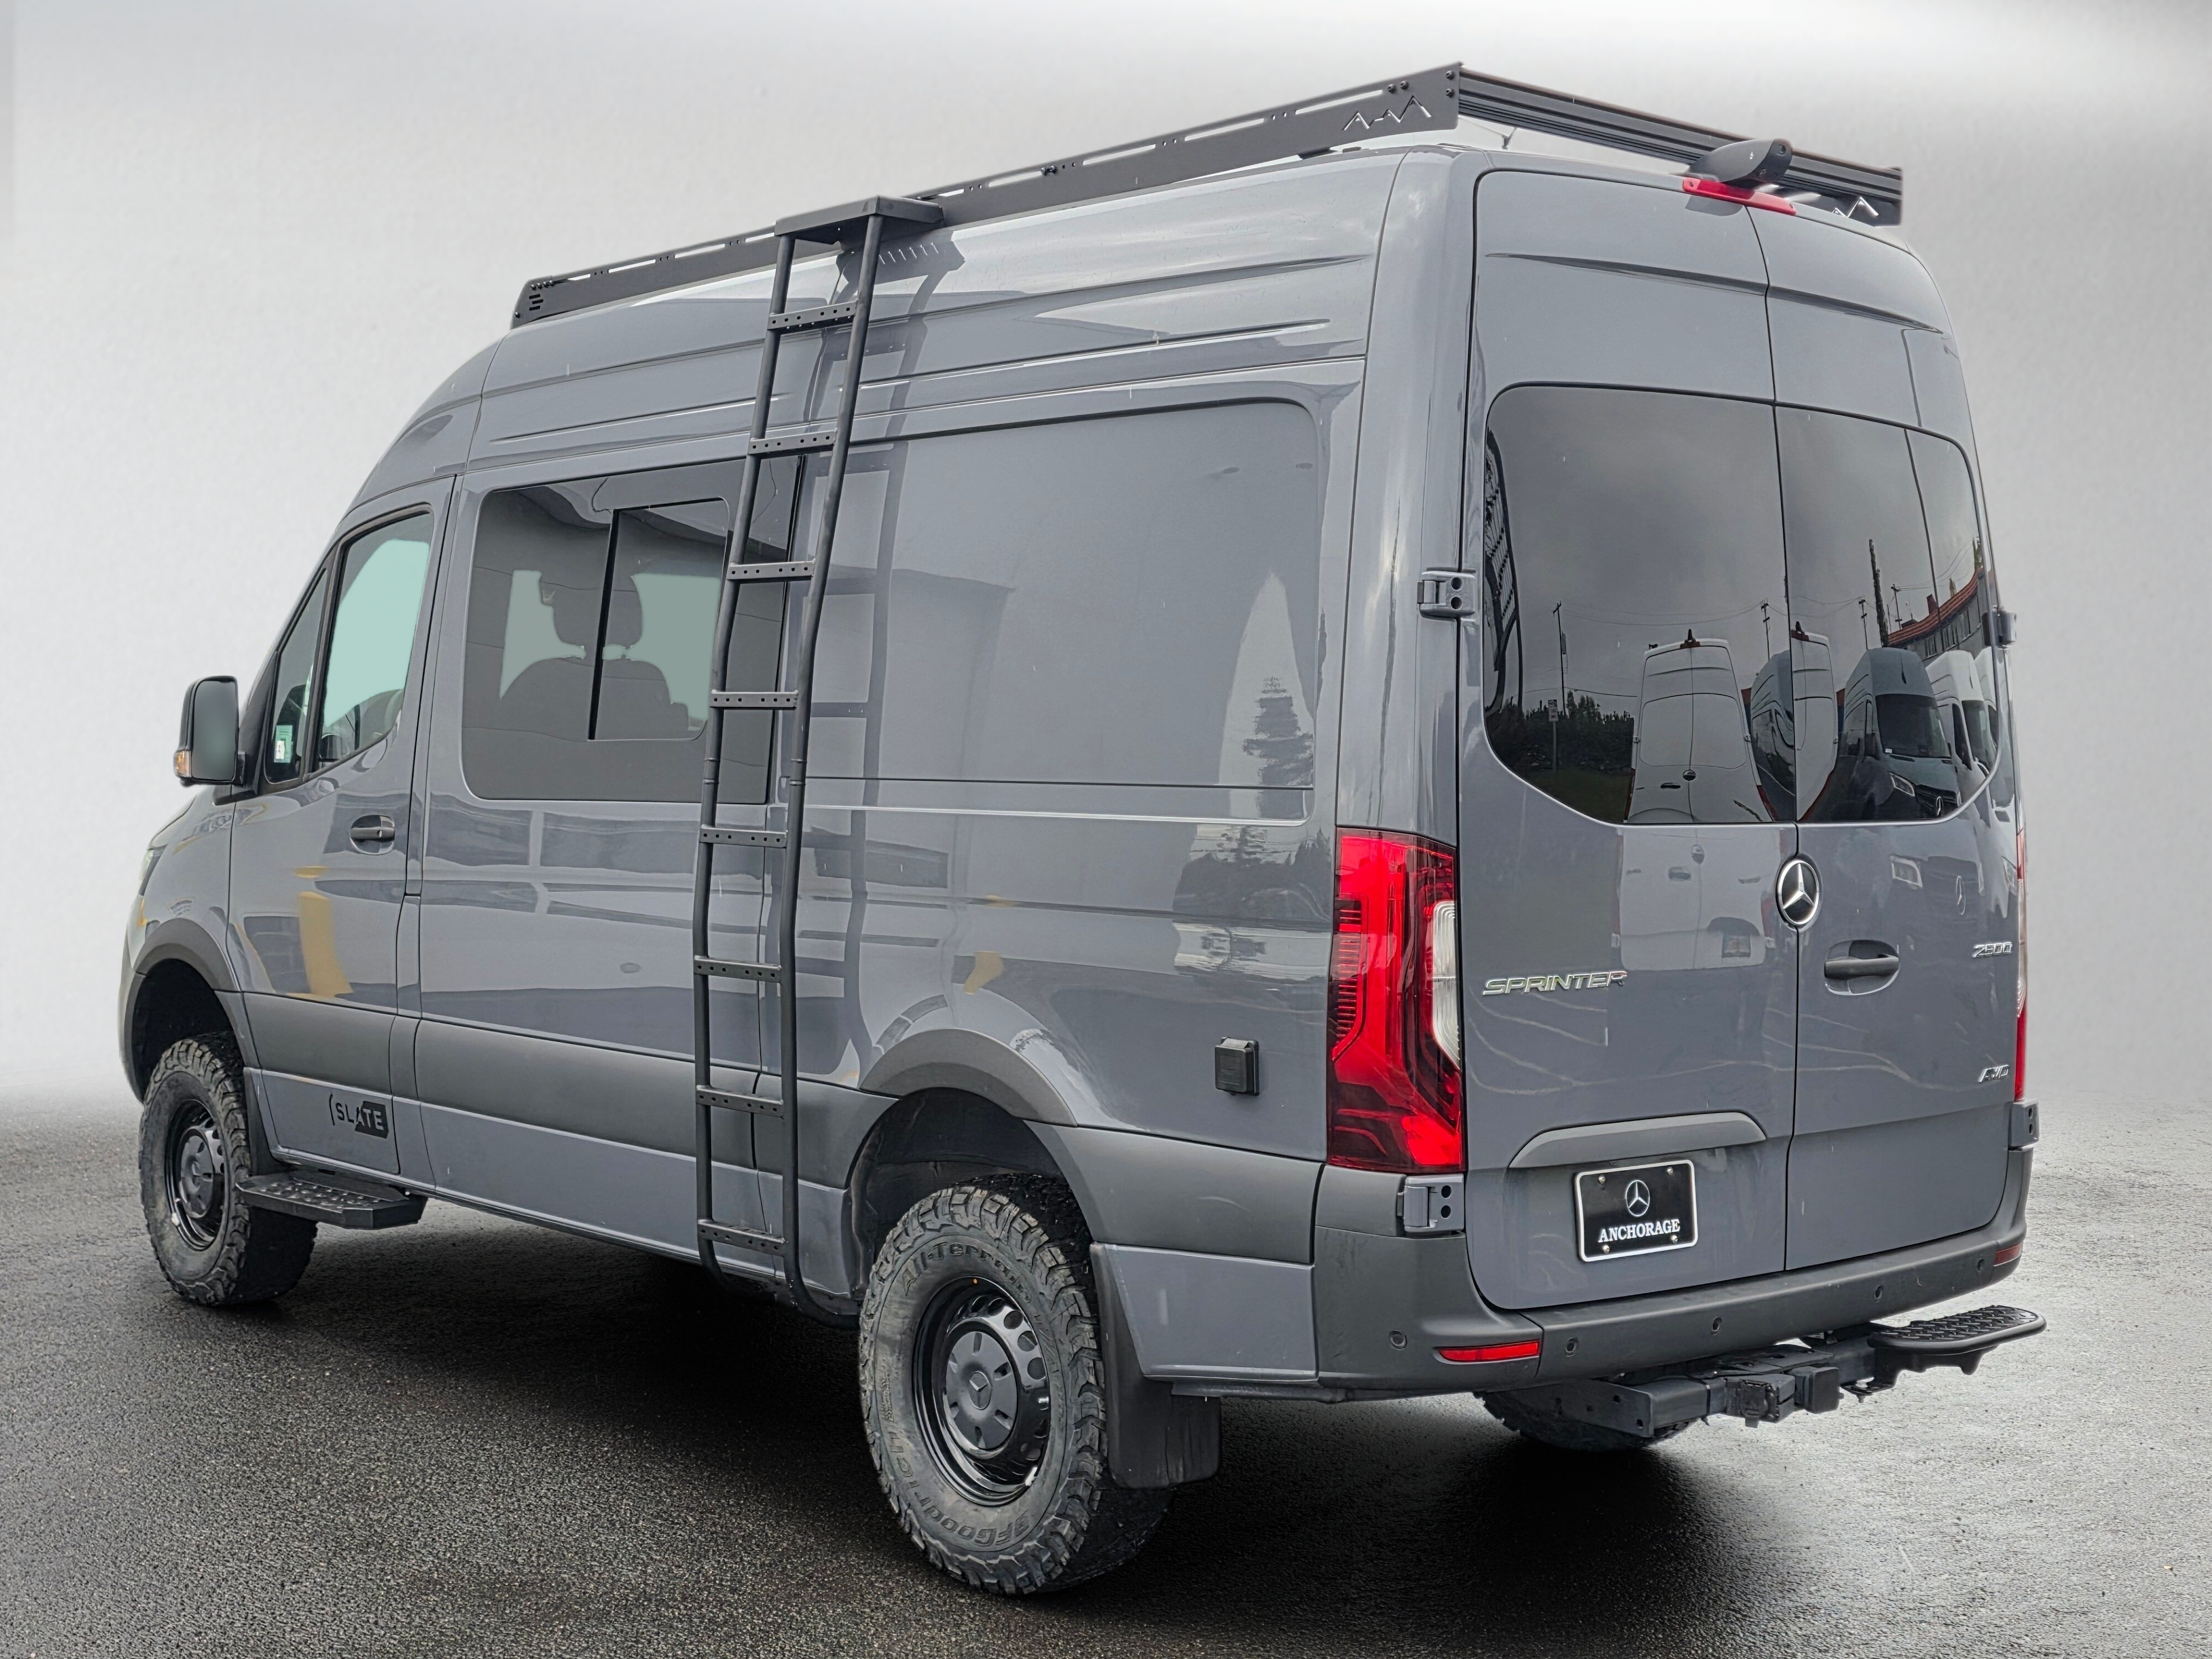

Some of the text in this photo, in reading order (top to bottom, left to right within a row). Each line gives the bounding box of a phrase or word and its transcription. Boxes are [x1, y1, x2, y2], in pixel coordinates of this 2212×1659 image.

[1483, 971, 1627, 995] SPRINTER
[335, 1102, 384, 1131] SLATE
[1598, 1219, 1681, 1243] ANCHORAGE
